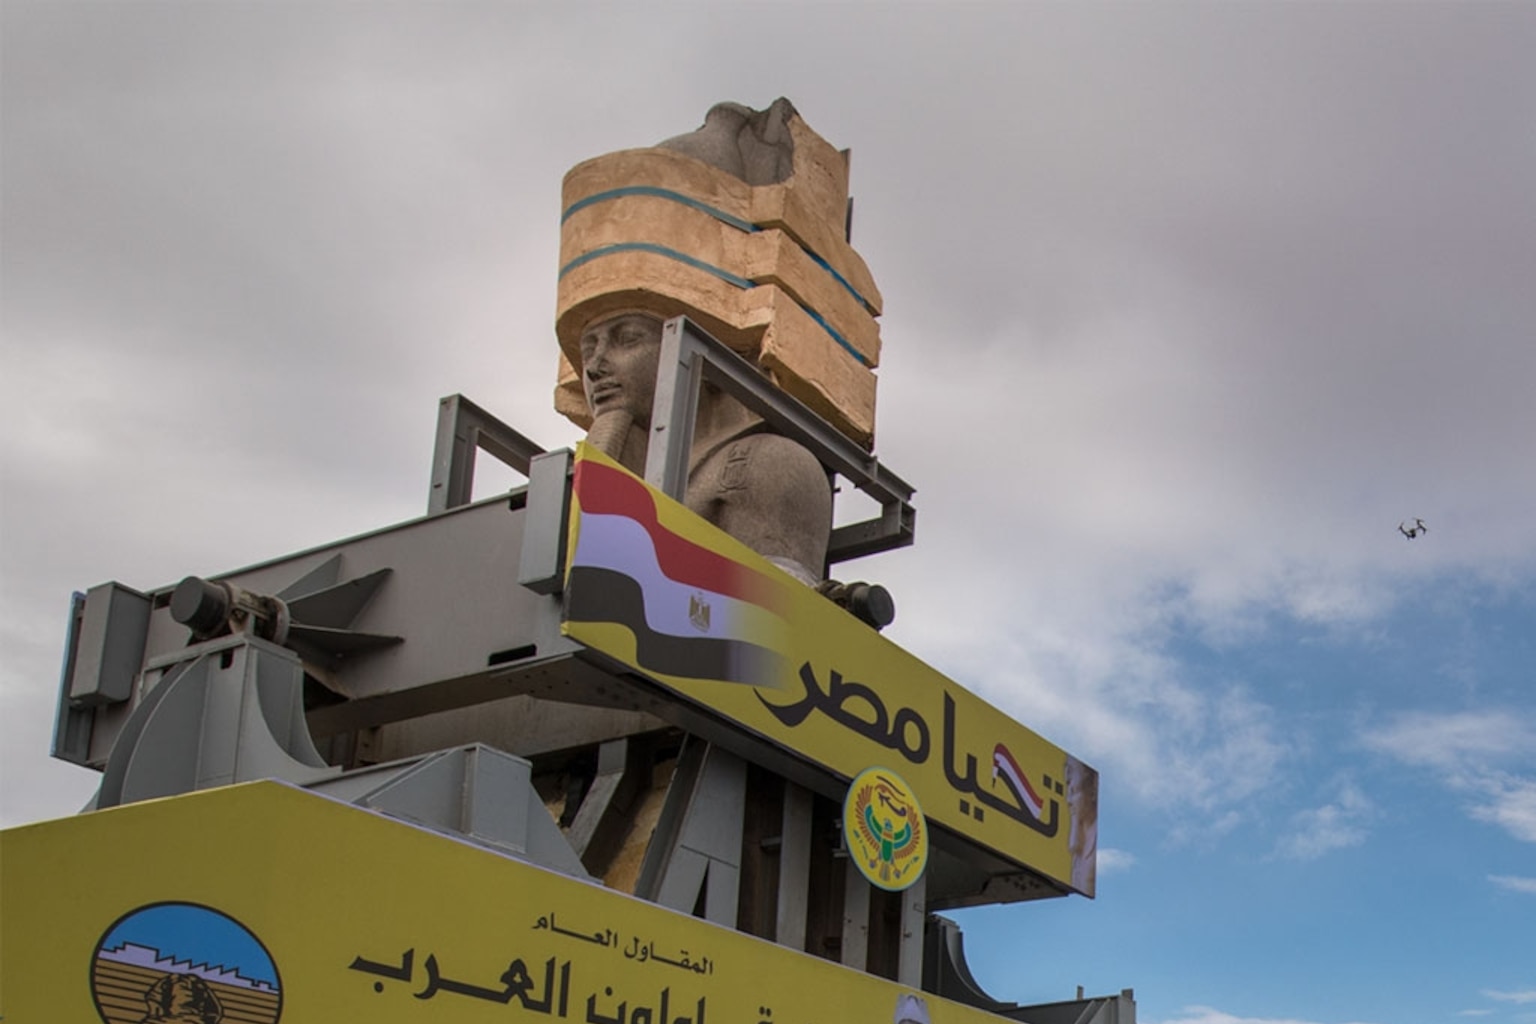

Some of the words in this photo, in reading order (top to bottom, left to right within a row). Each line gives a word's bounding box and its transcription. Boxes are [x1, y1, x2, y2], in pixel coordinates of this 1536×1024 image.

[753, 660, 931, 765] مصر
[943, 689, 1064, 838] تحيا
[532, 912, 617, 948] العام
[625, 938, 713, 975] المقاول
[348, 948, 570, 1017] العرب
